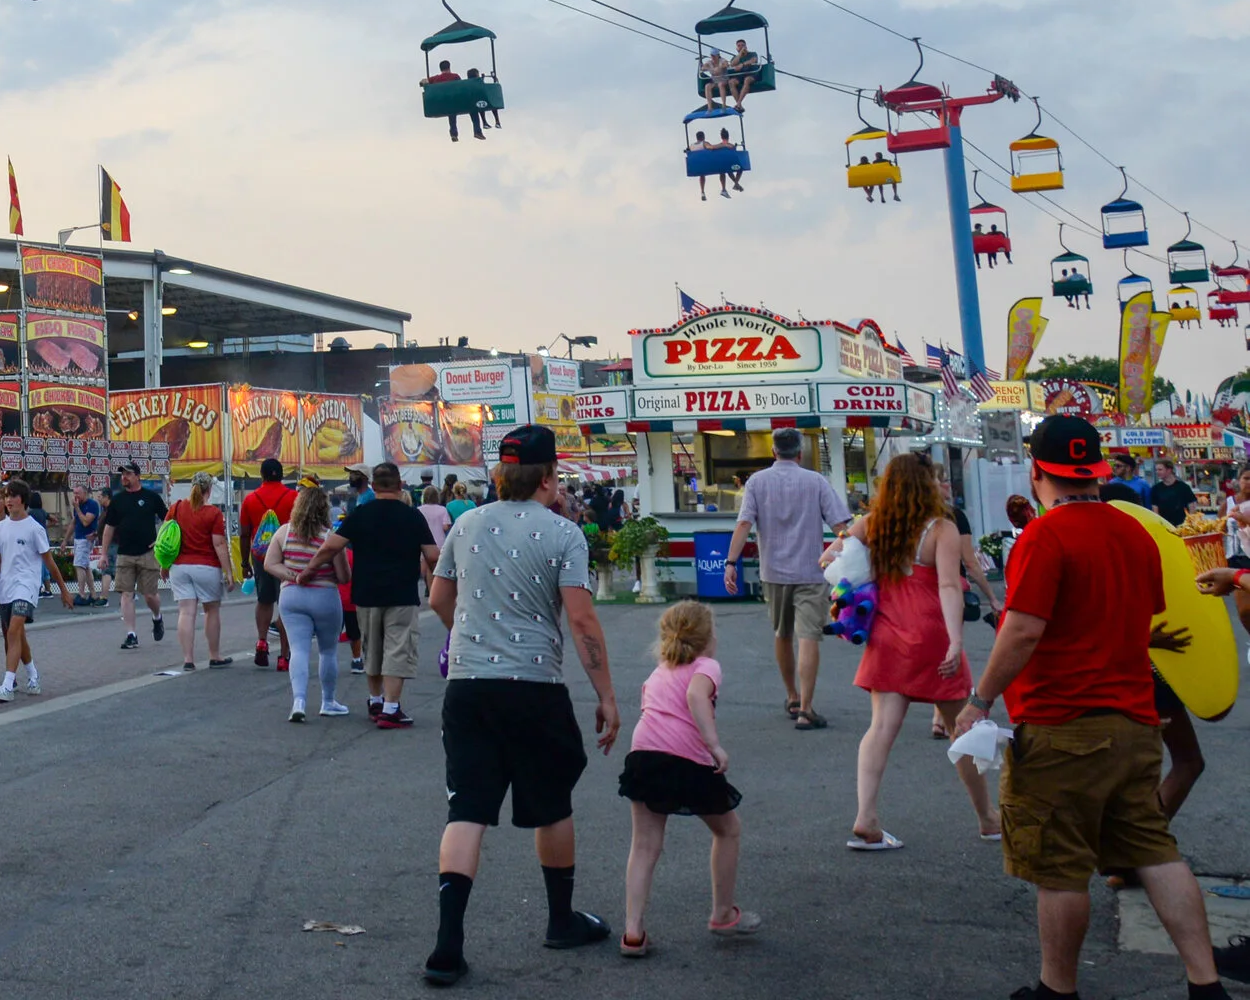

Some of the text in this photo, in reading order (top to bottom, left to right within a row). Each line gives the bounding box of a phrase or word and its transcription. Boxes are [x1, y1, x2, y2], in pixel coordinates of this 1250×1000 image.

[683, 317, 776, 339] Whole World
[663, 335, 801, 364] PIZZA
[446, 370, 505, 385] Donut Burger
[637, 390, 806, 412] Original PIZZA By Dor-Lo
[846, 386, 895, 397] COLD
[996, 396, 1021, 404] FRIES
[1062, 383, 1085, 405] DOGS
[110, 392, 217, 435] TURKEY LEGS
[501, 408, 515, 420] BUN
[833, 399, 903, 410] DRINKS
[232, 397, 297, 435] TURKEY LEGS
[304, 400, 362, 446] ROASTED CORN
[383, 410, 399, 426] ROAST
[399, 408, 413, 420] BEEF
[1069, 439, 1086, 460] C
[697, 559, 728, 571] AQUAF
